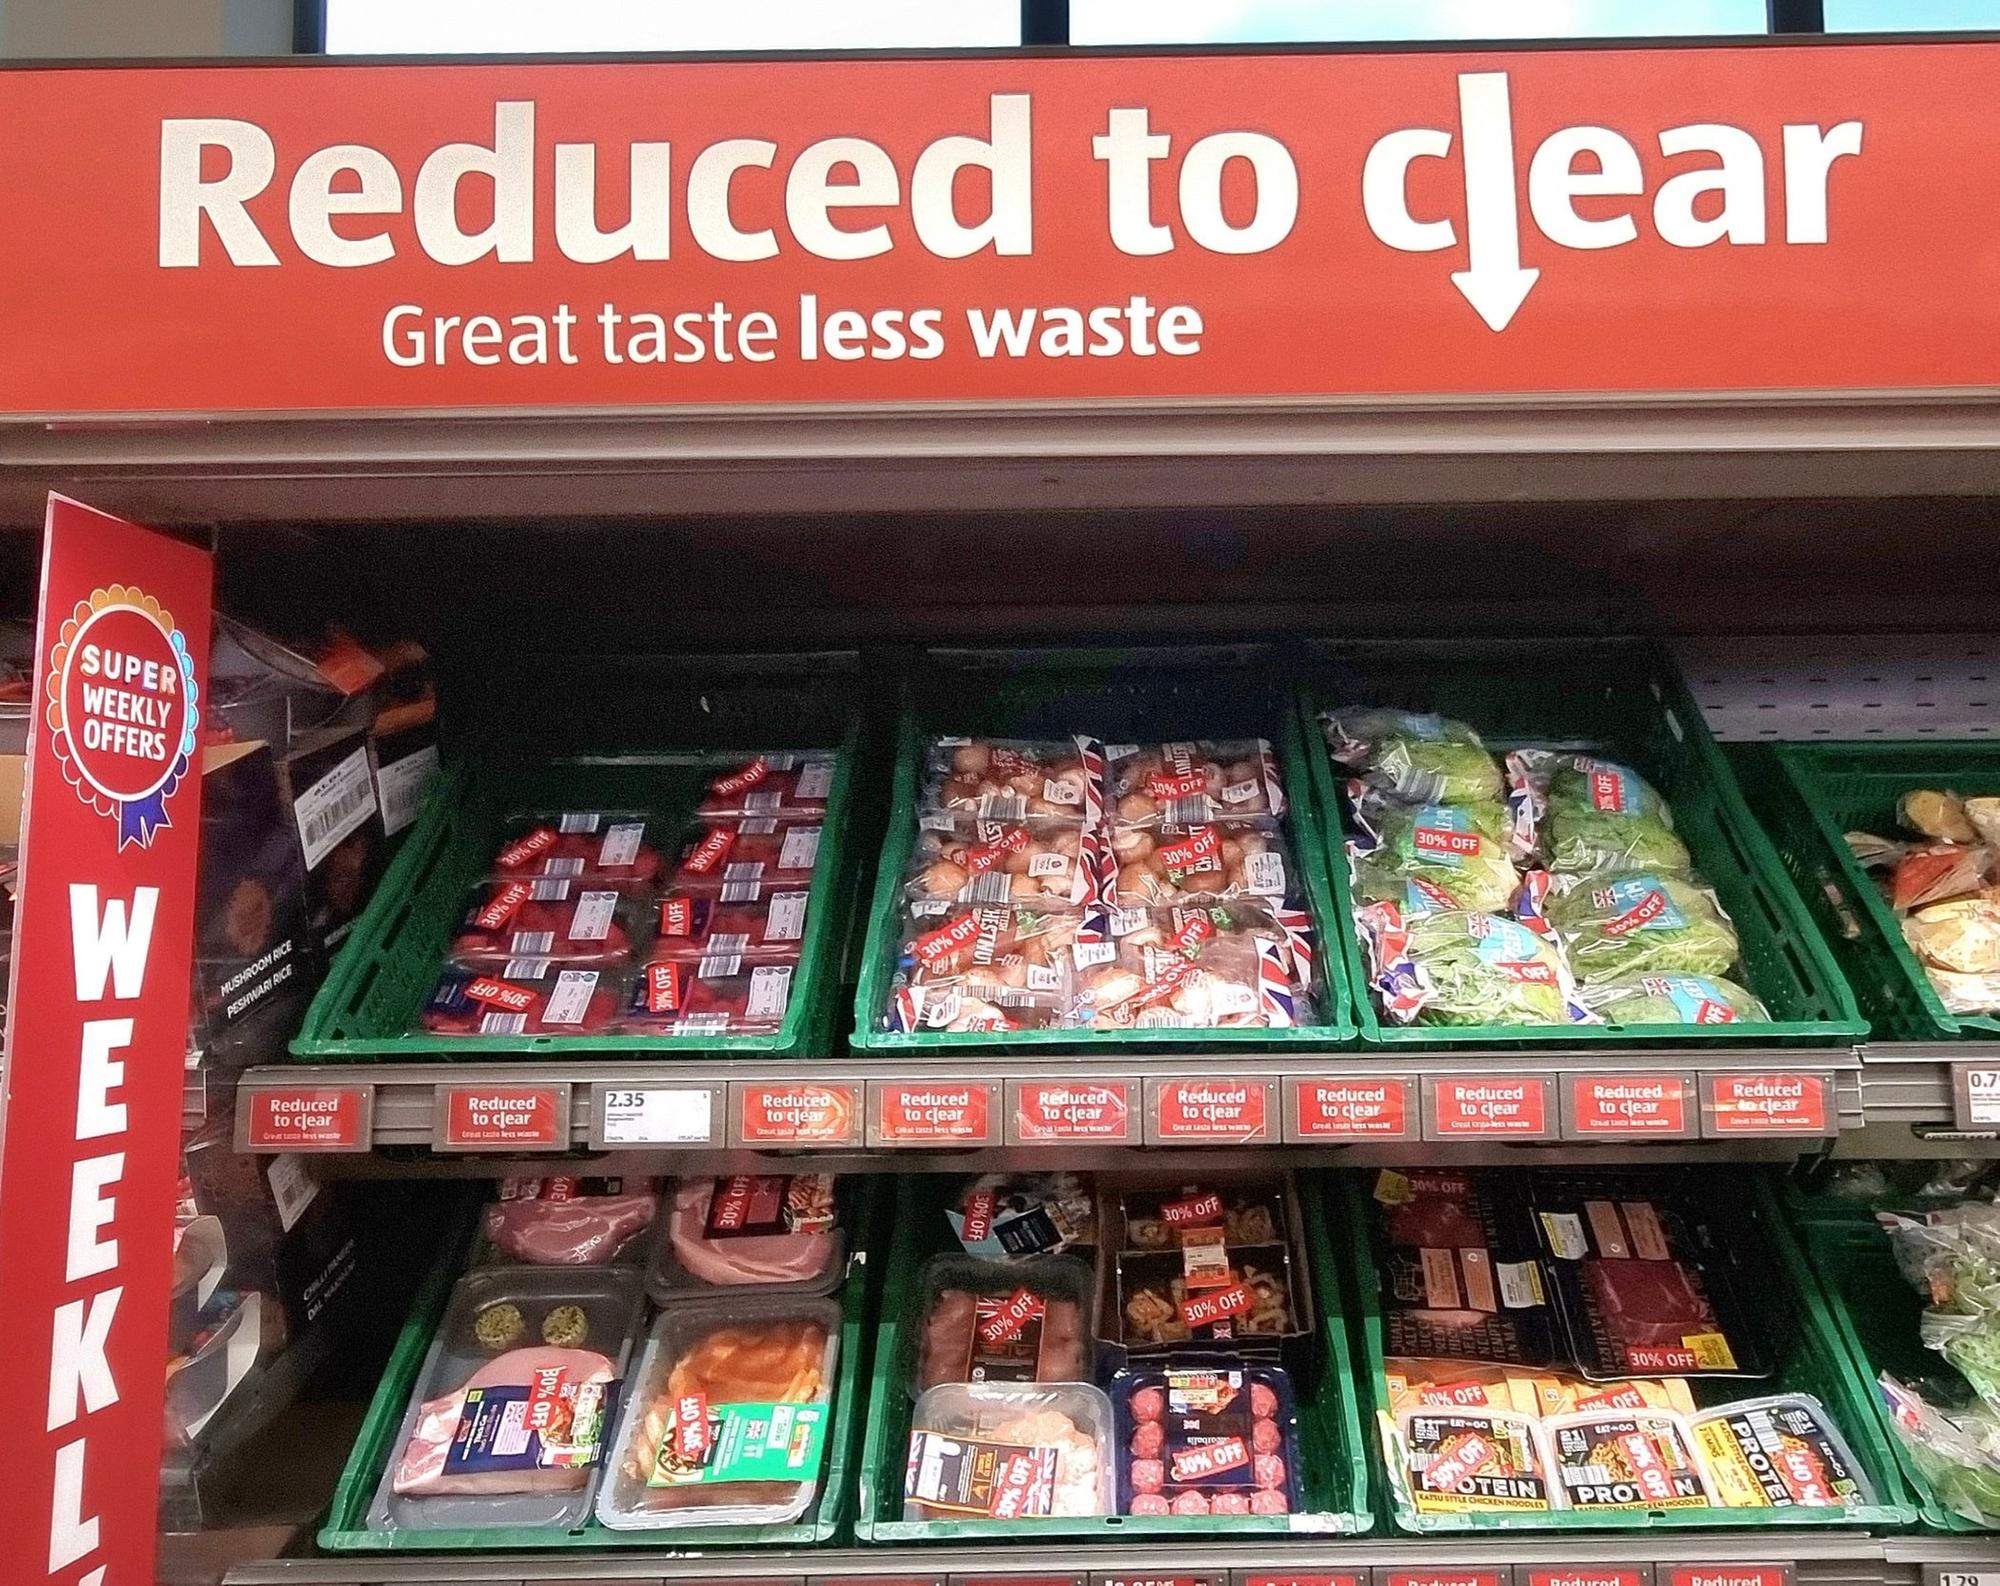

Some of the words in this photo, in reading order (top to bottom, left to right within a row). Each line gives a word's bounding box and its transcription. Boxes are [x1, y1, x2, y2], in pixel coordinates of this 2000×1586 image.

[158, 94, 1032, 269] Reduced
[1092, 106, 1299, 258] to
[1361, 70, 1864, 333] clear
[381, 303, 579, 368] Great
[597, 300, 779, 365] taste
[800, 294, 944, 362] less
[966, 295, 1203, 358] waste
[80, 643, 177, 696] SUPER
[82, 683, 171, 729] WEEKLY
[83, 725, 167, 762] OFFERS
[744, 762, 764, 782] OFF
[1152, 781, 1178, 796] 30%
[531, 829, 550, 850] OFF
[1163, 849, 1193, 866] 30%
[1193, 831, 1216, 855] OFF
[1417, 831, 1448, 847] 30%
[1451, 837, 1478, 850] OFF
[690, 848, 714, 872] 30%
[709, 831, 729, 853] OFF
[481, 903, 509, 927] 30%
[505, 883, 526, 905] OFF
[1637, 894, 1664, 919] OFF
[921, 935, 953, 958] 30%
[950, 918, 977, 941] OFF
[1180, 921, 1205, 946] OFF
[220, 951, 273, 996] MUSHROOM
[272, 939, 293, 963] RICE
[1520, 965, 1550, 980] OFF
[655, 967, 672, 990] OFF
[226, 976, 273, 1019] PESHWARI
[271, 963, 293, 987] RICE
[468, 982, 499, 997] OFF
[501, 988, 531, 1006] 30%
[1970, 1072, 2000, 1088] 0.7
[900, 1092, 969, 1107] Reduced
[1038, 1090, 1107, 1106] Reduced
[1177, 1089, 1246, 1104] Reduced
[1317, 1088, 1385, 1102] Reduced
[1455, 1086, 1523, 1101] Reduced
[1593, 1085, 1663, 1099] Reduced
[1733, 1083, 1802, 1098] Reduced
[270, 1097, 337, 1113] Reduced
[468, 1096, 537, 1111] Reduced
[607, 1092, 645, 1108] 2.35
[762, 1093, 832, 1108] Reduced
[1598, 1100, 1616, 1114] to
[1620, 1099, 1659, 1117] clear
[1760, 1098, 1799, 1115] clear
[767, 1109, 783, 1122] to
[787, 1107, 826, 1125] clear
[905, 1107, 921, 1121] to
[925, 1106, 964, 1124] clear
[1042, 1106, 1058, 1120] to
[1064, 1106, 1102, 1124] clear
[1182, 1104, 1199, 1118] to
[1202, 1104, 1242, 1121] clear
[1321, 1103, 1337, 1117] to
[1342, 1102, 1380, 1120] clear
[1460, 1102, 1477, 1116] to
[1481, 1101, 1520, 1119] clear
[274, 1113, 290, 1127] to
[294, 1112, 333, 1130] clear
[473, 1111, 489, 1125] to
[492, 1111, 532, 1129] clear
[1411, 1179, 1440, 1193] 30%
[1440, 1181, 1465, 1194] OFF
[719, 1198, 742, 1228] 30%
[1163, 1205, 1193, 1221] 30%
[1195, 1197, 1219, 1216] OFF
[47, 884, 160, 1586] WEEKL
[967, 1219, 985, 1241] OFF
[1184, 1298, 1218, 1321] 30%
[1218, 1289, 1246, 1310] OFF
[983, 1314, 1014, 1341] 30%
[1010, 1292, 1034, 1319] OFF
[1629, 1352, 1664, 1367] 30%
[1666, 1352, 1695, 1367] OFF
[1420, 1391, 1454, 1408] 30%
[1454, 1385, 1483, 1404] OFF
[1612, 1390, 1641, 1408] OFF
[529, 1401, 551, 1428] OFF
[680, 1397, 700, 1421] OFF
[1177, 1451, 1212, 1475] 30%
[1212, 1441, 1243, 1465] OFF
[1457, 1437, 1487, 1464] OFF
[1008, 1457, 1033, 1485] OFF
[1785, 1451, 1813, 1481] OFF
[1421, 1472, 1537, 1498] POTEIN
[1445, 1495, 1468, 1504] STYLE
[1468, 1497, 1505, 1507] CHICKEN
[1505, 1499, 1545, 1509] NOODLES
[1941, 1574, 1978, 1586] 179
